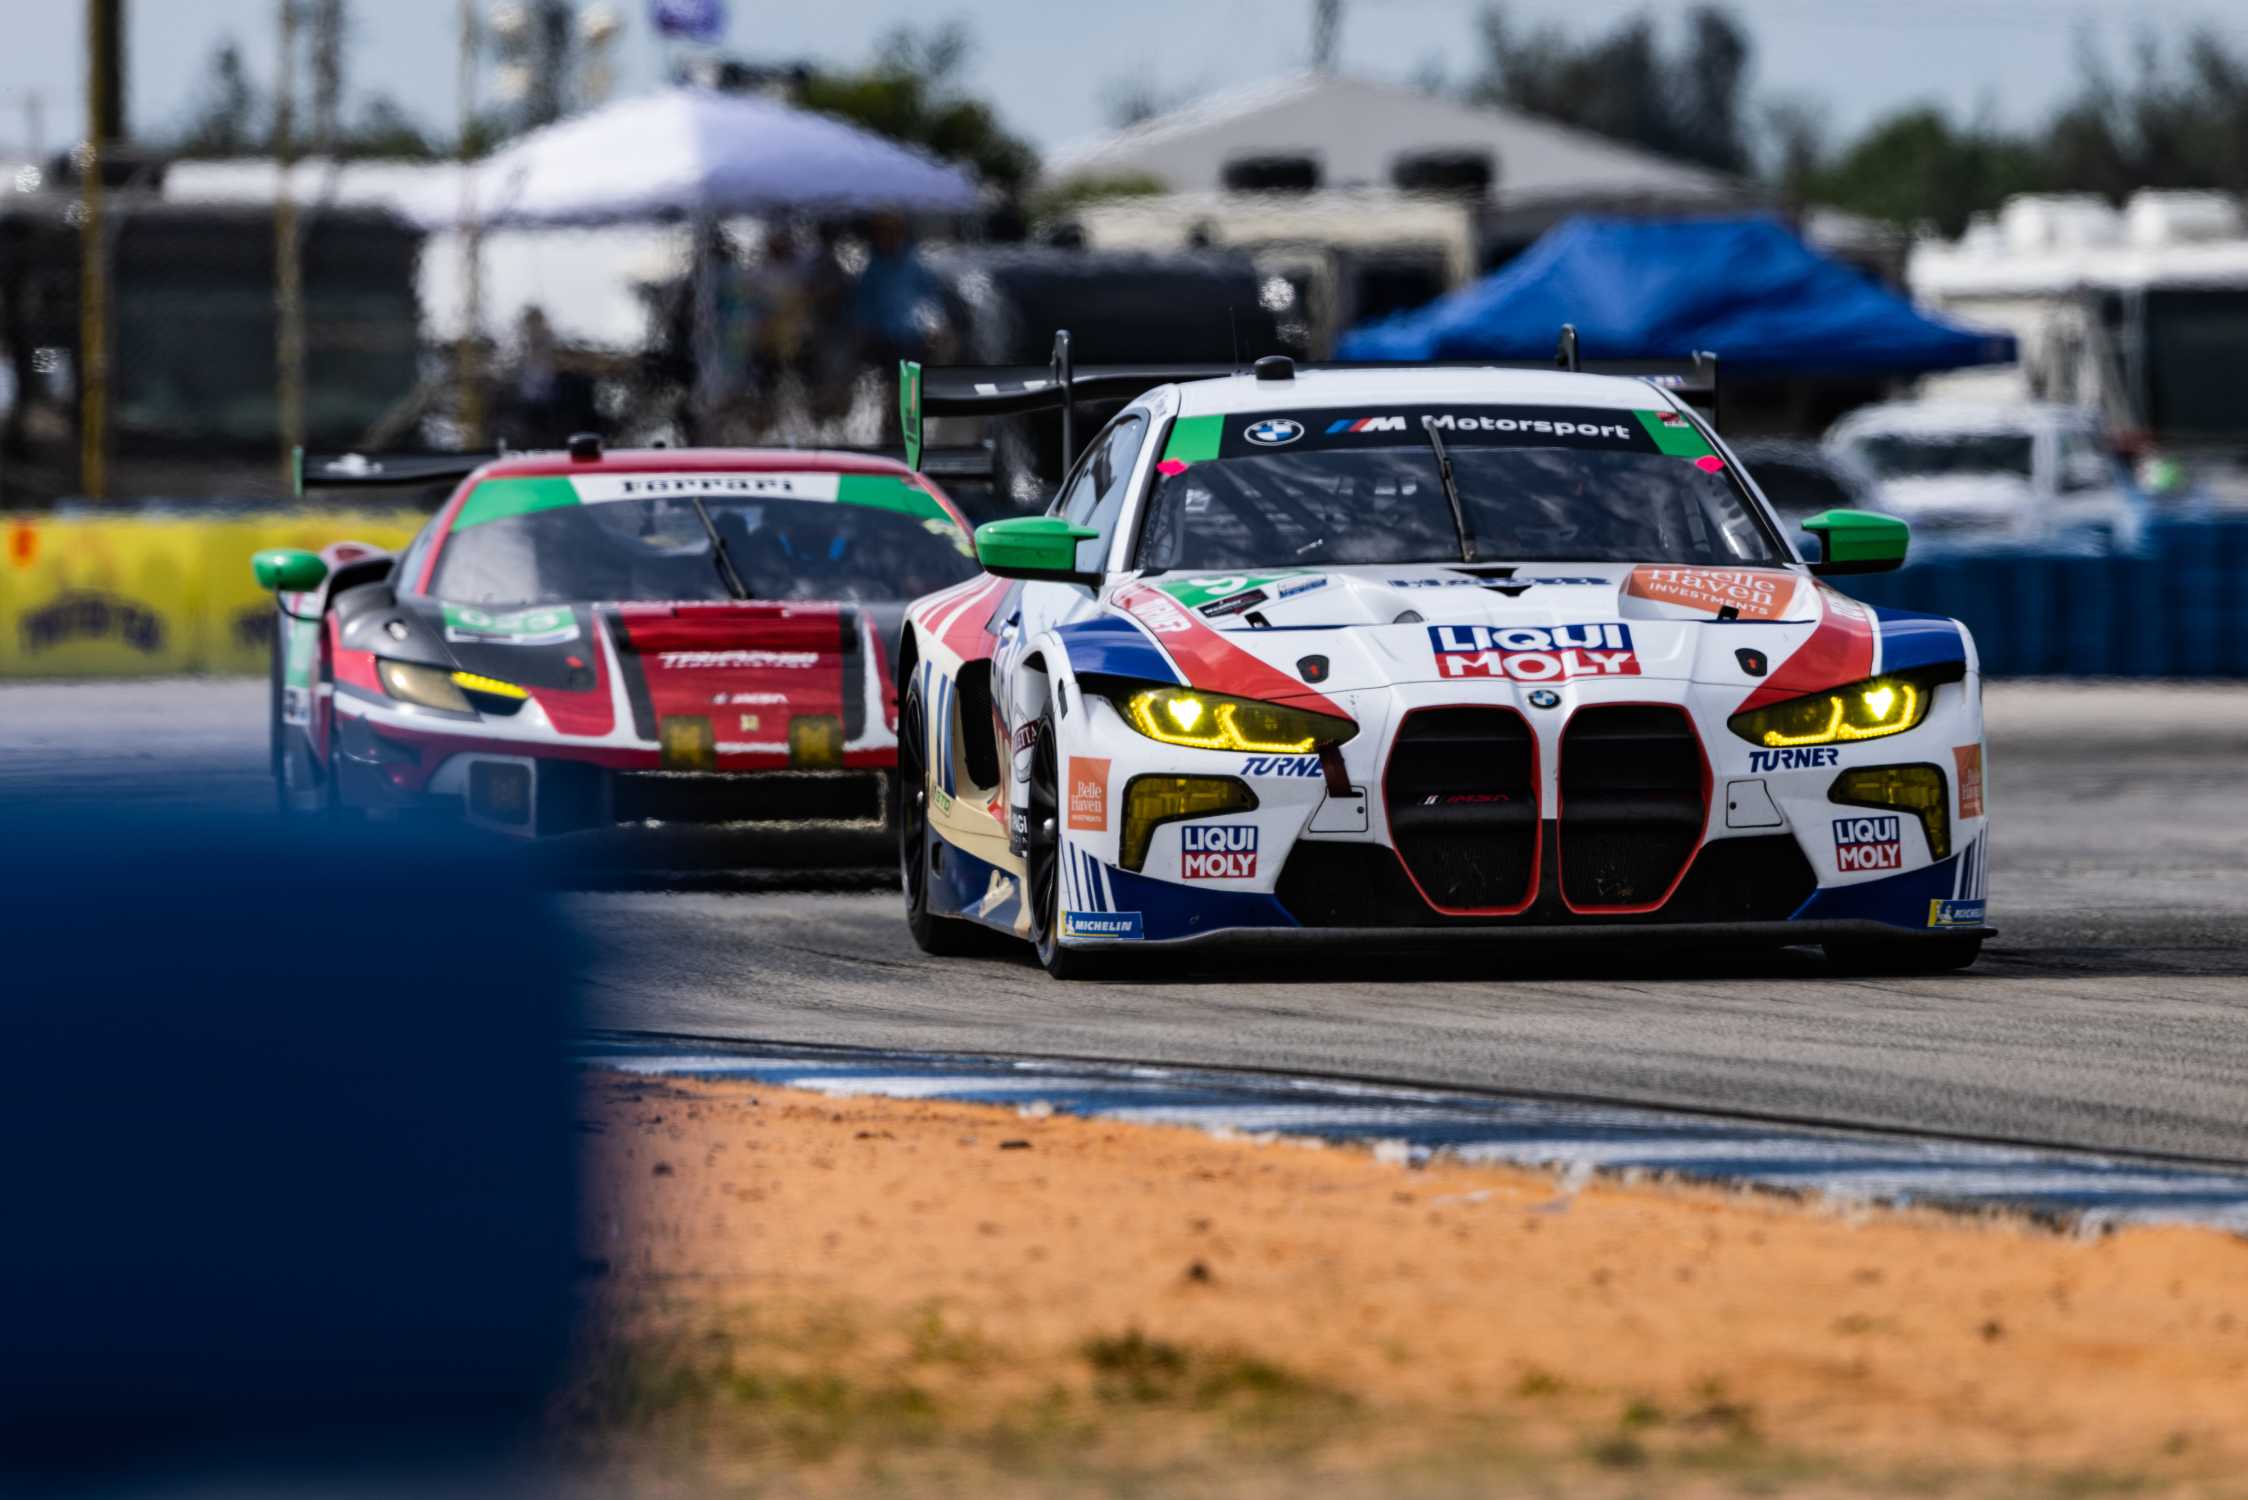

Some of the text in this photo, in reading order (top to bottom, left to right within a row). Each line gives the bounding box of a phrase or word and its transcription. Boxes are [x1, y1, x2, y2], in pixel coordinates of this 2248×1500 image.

[1421, 415, 1630, 440] Motorsport
[1649, 582, 1769, 615] INVESTMENTS
[1437, 624, 1624, 651] LIQUI
[1445, 649, 1637, 681] MOLY
[1241, 757, 1323, 777] TURNE
[1749, 748, 1839, 773] TURNER
[1185, 827, 1254, 852] LIQUI
[1836, 817, 1898, 845] LIQUI
[1185, 854, 1255, 877] MOLY
[1839, 843, 1899, 870] MOLY
[1074, 919, 1133, 932] MICHELIN
